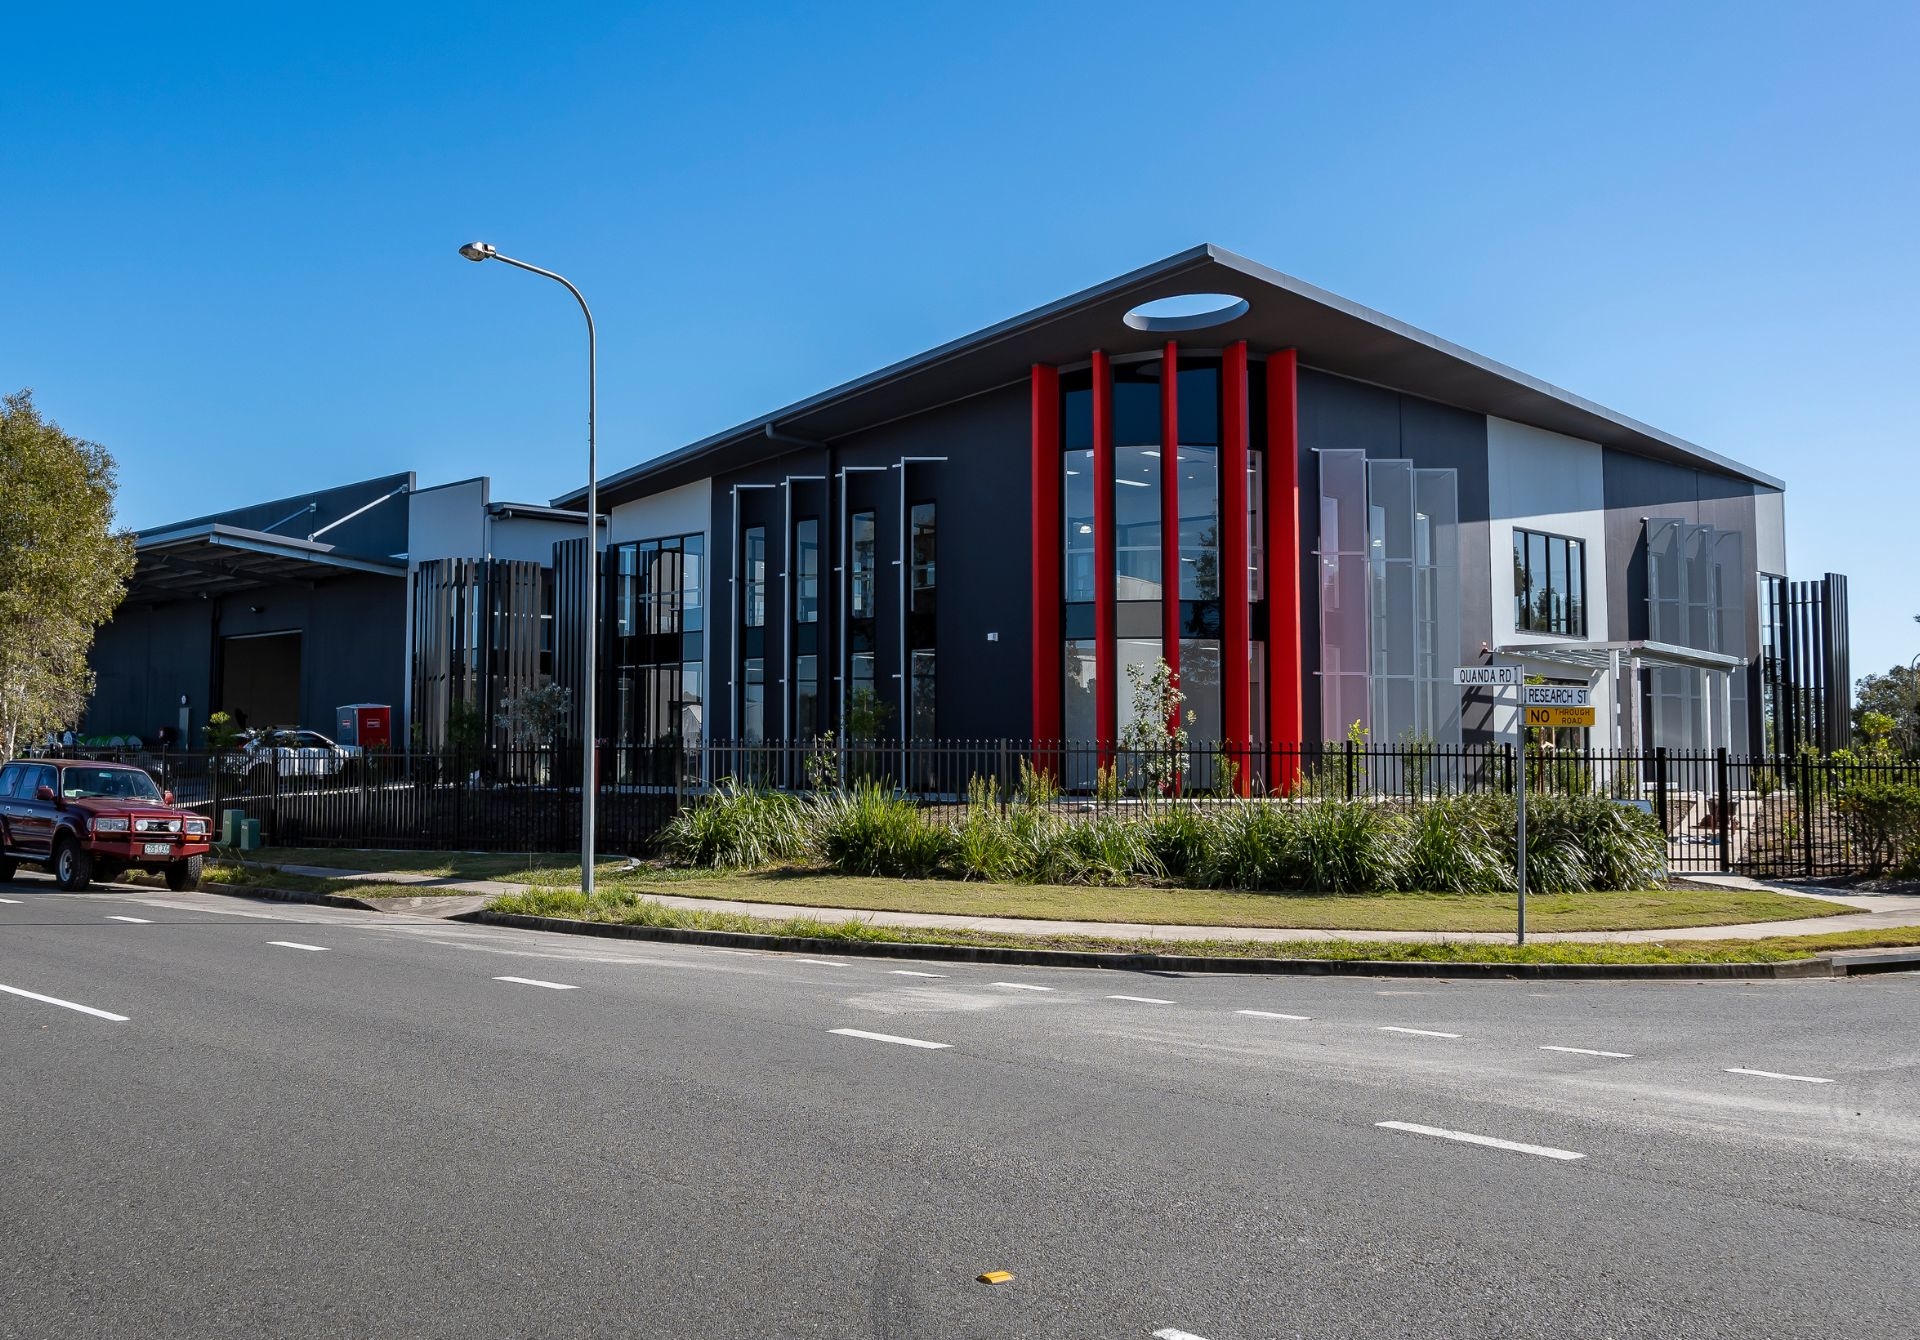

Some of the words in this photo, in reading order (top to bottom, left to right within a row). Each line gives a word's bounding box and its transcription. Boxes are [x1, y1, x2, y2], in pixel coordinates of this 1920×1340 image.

[1460, 669, 1496, 683] QUANDA
[1499, 669, 1512, 683] RD
[1528, 688, 1573, 704] RESEARCH
[1577, 689, 1588, 704] ST
[1530, 709, 1550, 723] NO
[1554, 708, 1590, 716] THROUGH
[1561, 717, 1583, 725] ROAD
